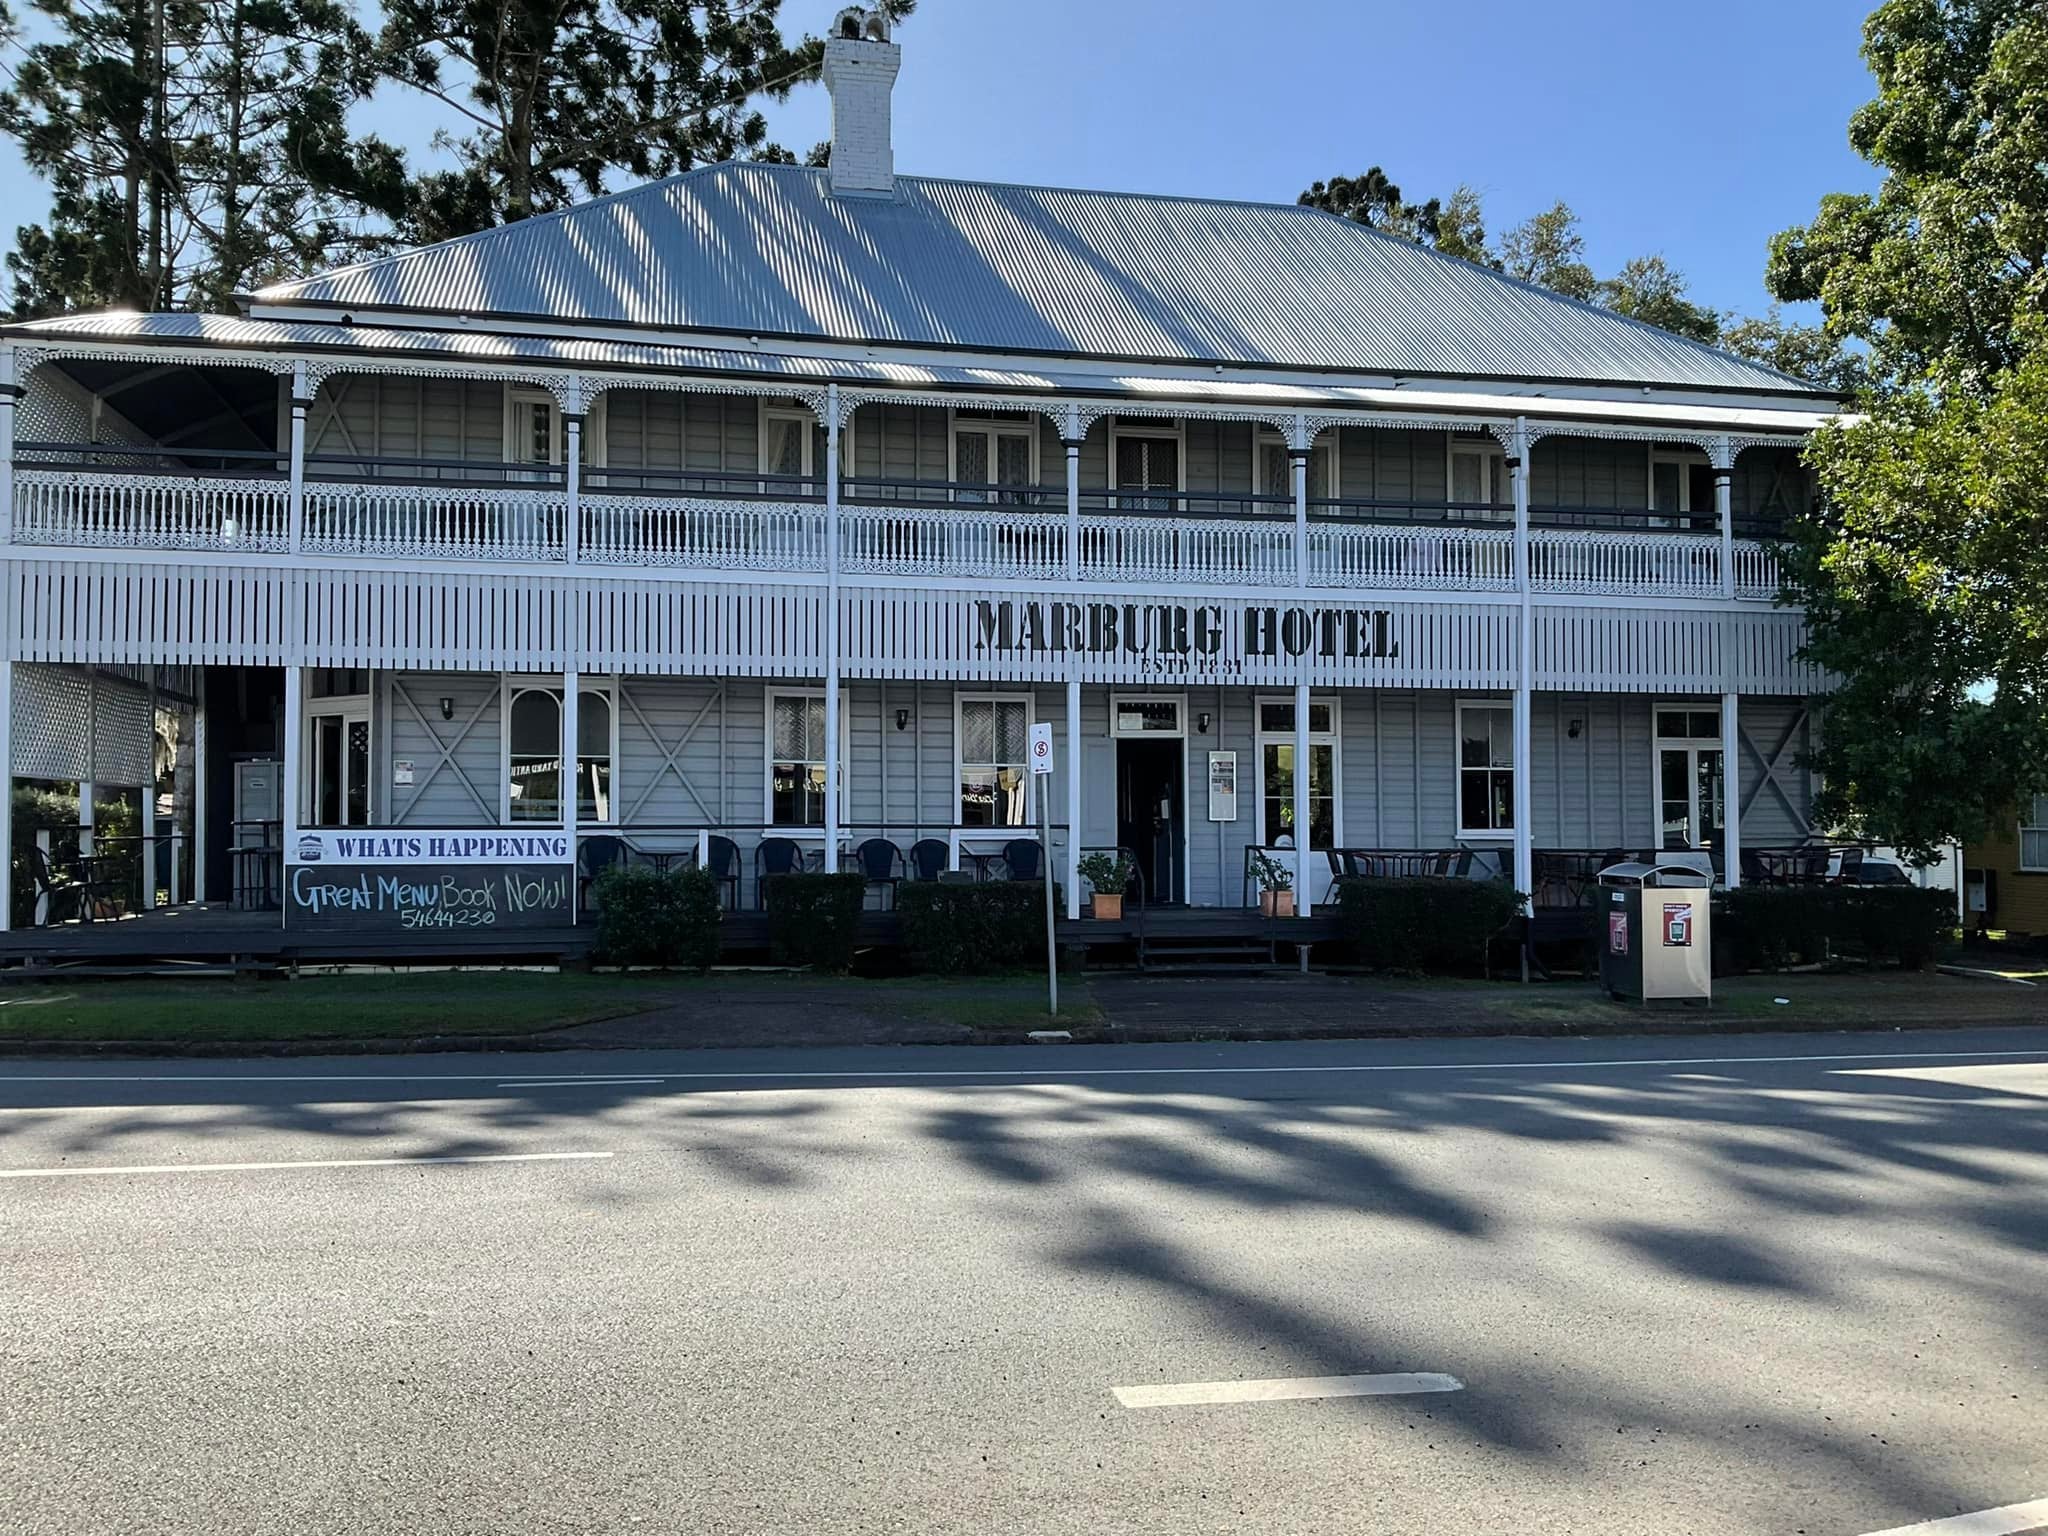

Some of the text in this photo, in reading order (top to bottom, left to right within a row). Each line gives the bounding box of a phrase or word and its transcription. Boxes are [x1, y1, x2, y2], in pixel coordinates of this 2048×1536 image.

[974, 599, 1399, 658] MARBURG HOTEL
[1141, 658, 1190, 674] ESTD
[336, 838, 567, 857] WHATS HAPPENING
[401, 908, 496, 928] 54644230
